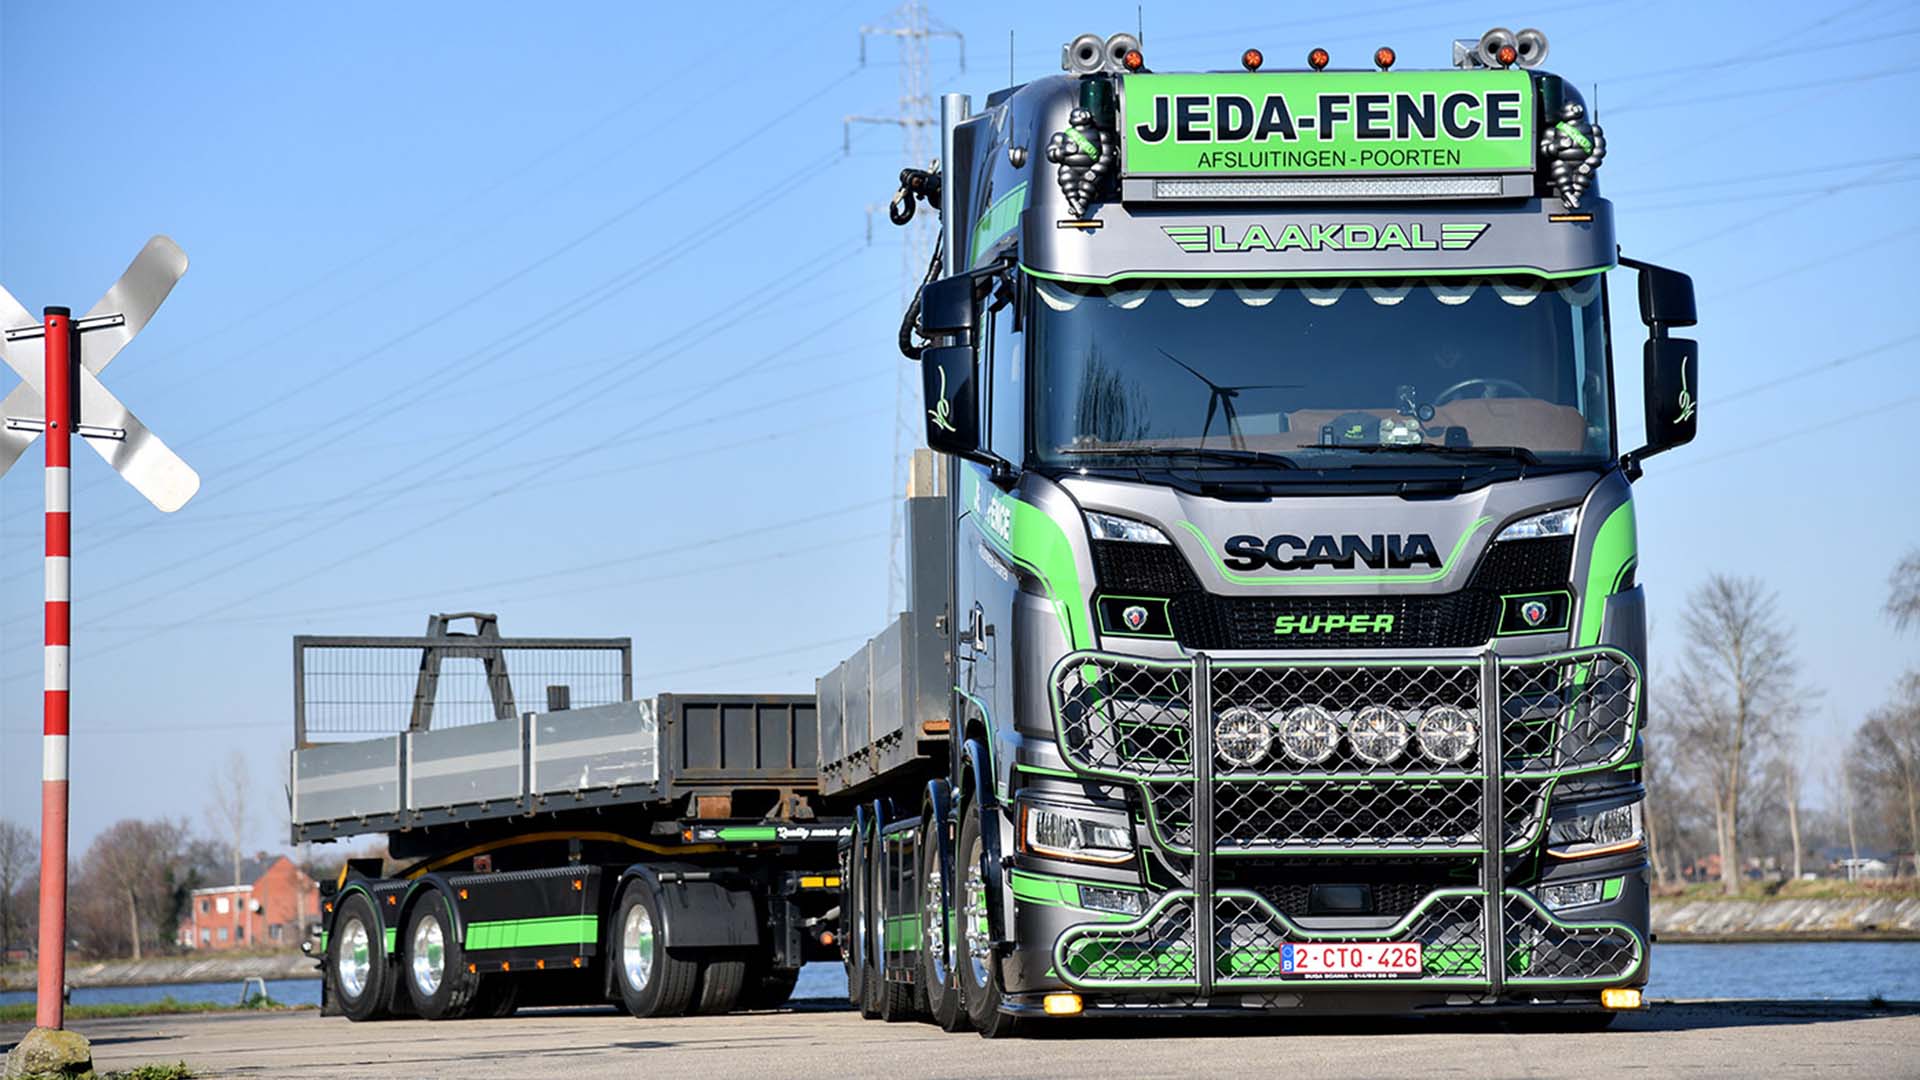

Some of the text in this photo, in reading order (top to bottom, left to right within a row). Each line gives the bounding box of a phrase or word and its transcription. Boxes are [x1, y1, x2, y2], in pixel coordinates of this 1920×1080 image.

[1136, 93, 1523, 143] JEDA-FENCE
[1197, 151, 1346, 168] AFSLUITINGEN
[1360, 148, 1461, 167] POORTEN
[1212, 223, 1438, 252] LAAKDAL
[1222, 533, 1444, 572] SCANIA
[1273, 614, 1395, 635] SUPER
[1283, 960, 1293, 972] B
